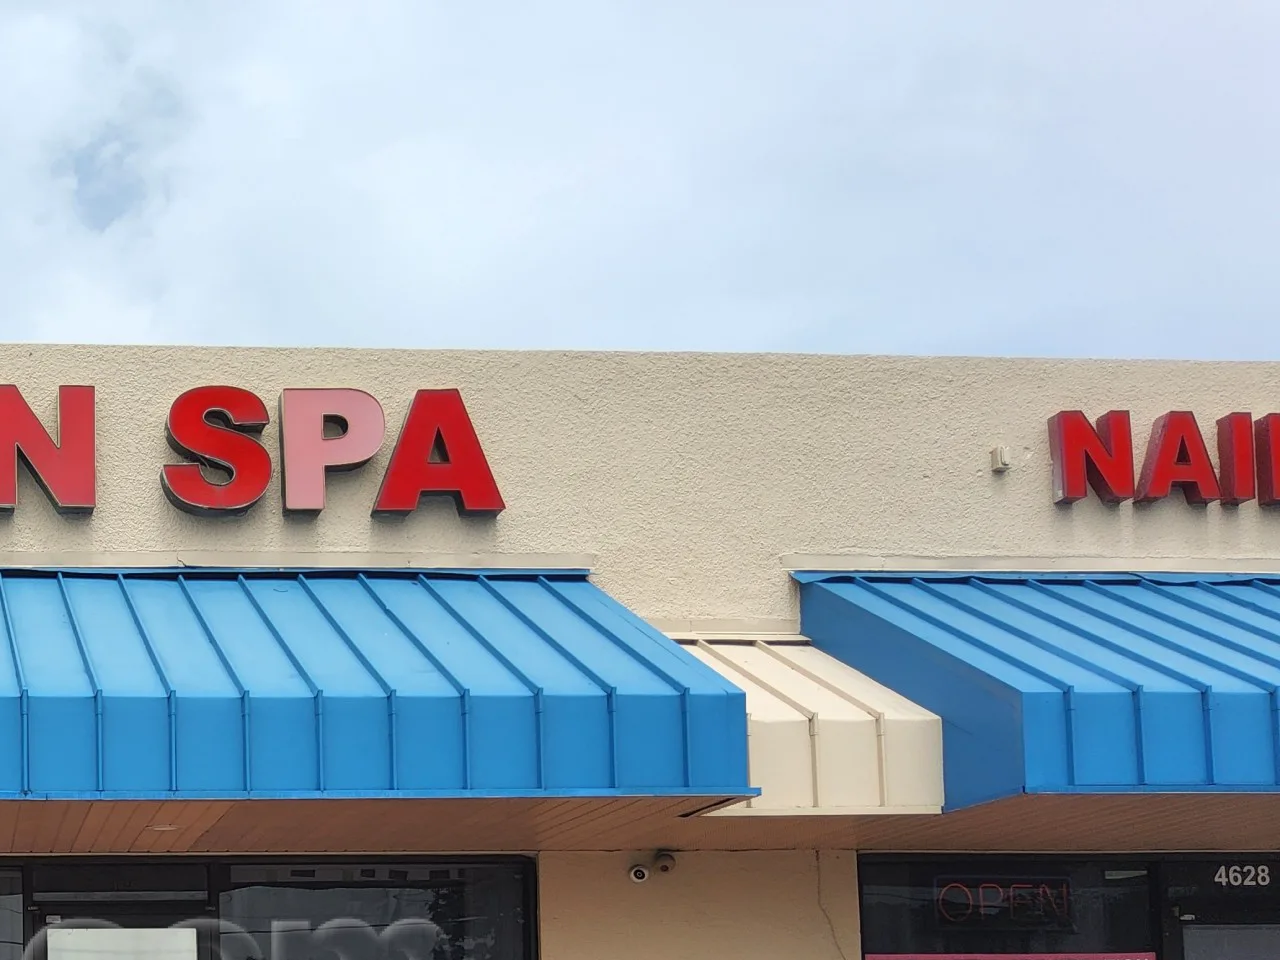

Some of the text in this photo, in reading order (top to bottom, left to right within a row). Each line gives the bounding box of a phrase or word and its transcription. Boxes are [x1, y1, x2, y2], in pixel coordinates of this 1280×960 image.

[159, 385, 505, 518] SPA
[1214, 865, 1270, 886] 4628
[938, 883, 1068, 922] OPEN
